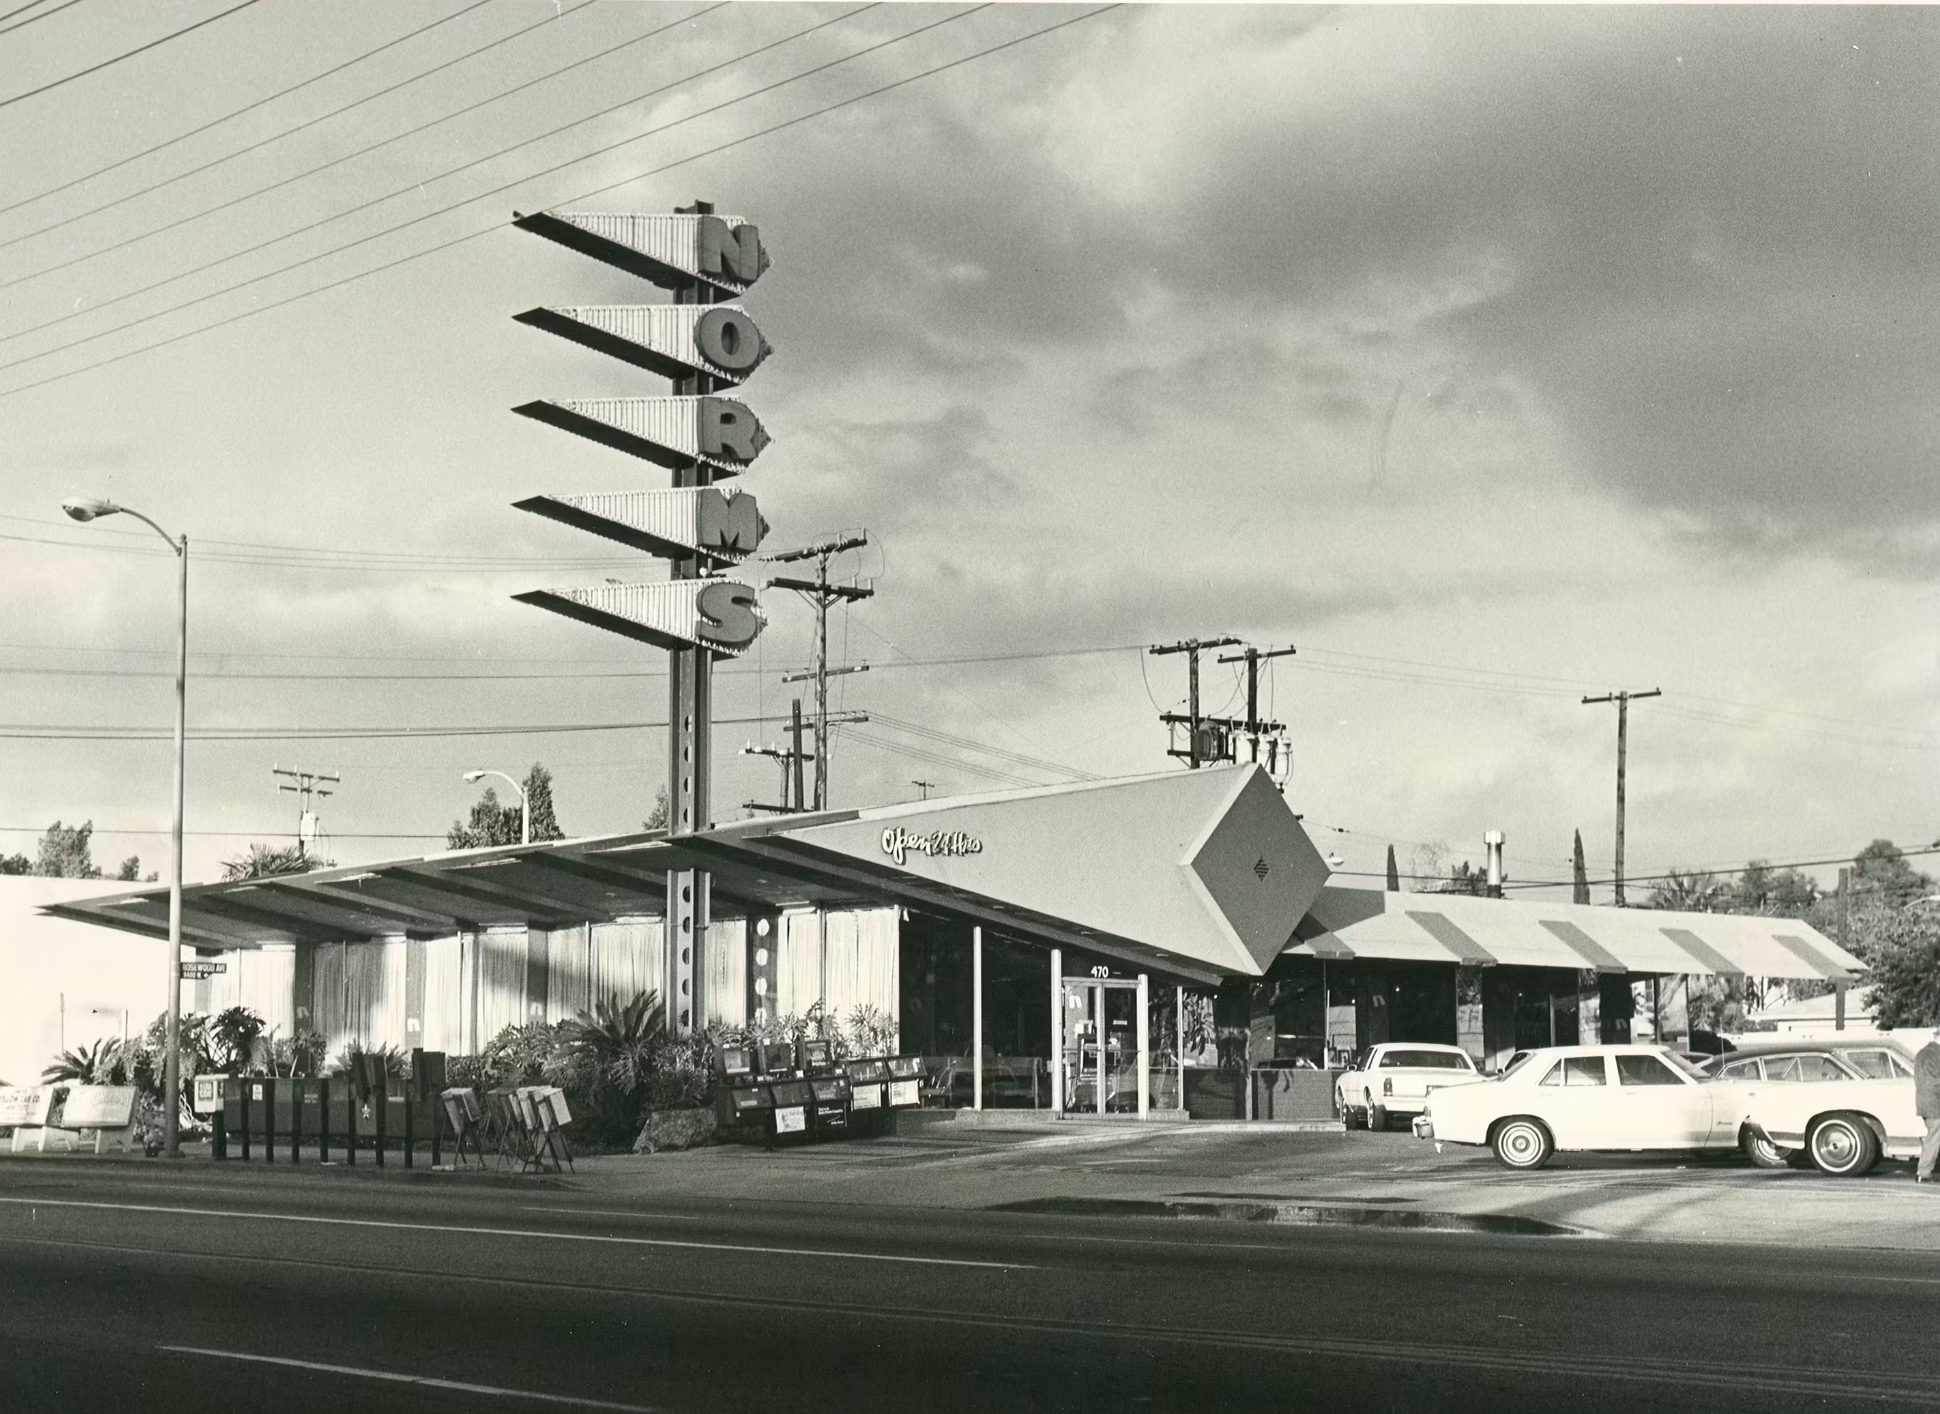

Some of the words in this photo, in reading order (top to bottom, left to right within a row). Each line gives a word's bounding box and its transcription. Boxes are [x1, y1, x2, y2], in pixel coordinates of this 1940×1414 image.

[693, 214, 762, 648] NORMS
[881, 826, 932, 865] Open
[931, 830, 951, 856] 24
[216, 964, 226, 973] AVE
[1090, 965, 1109, 978] 470
